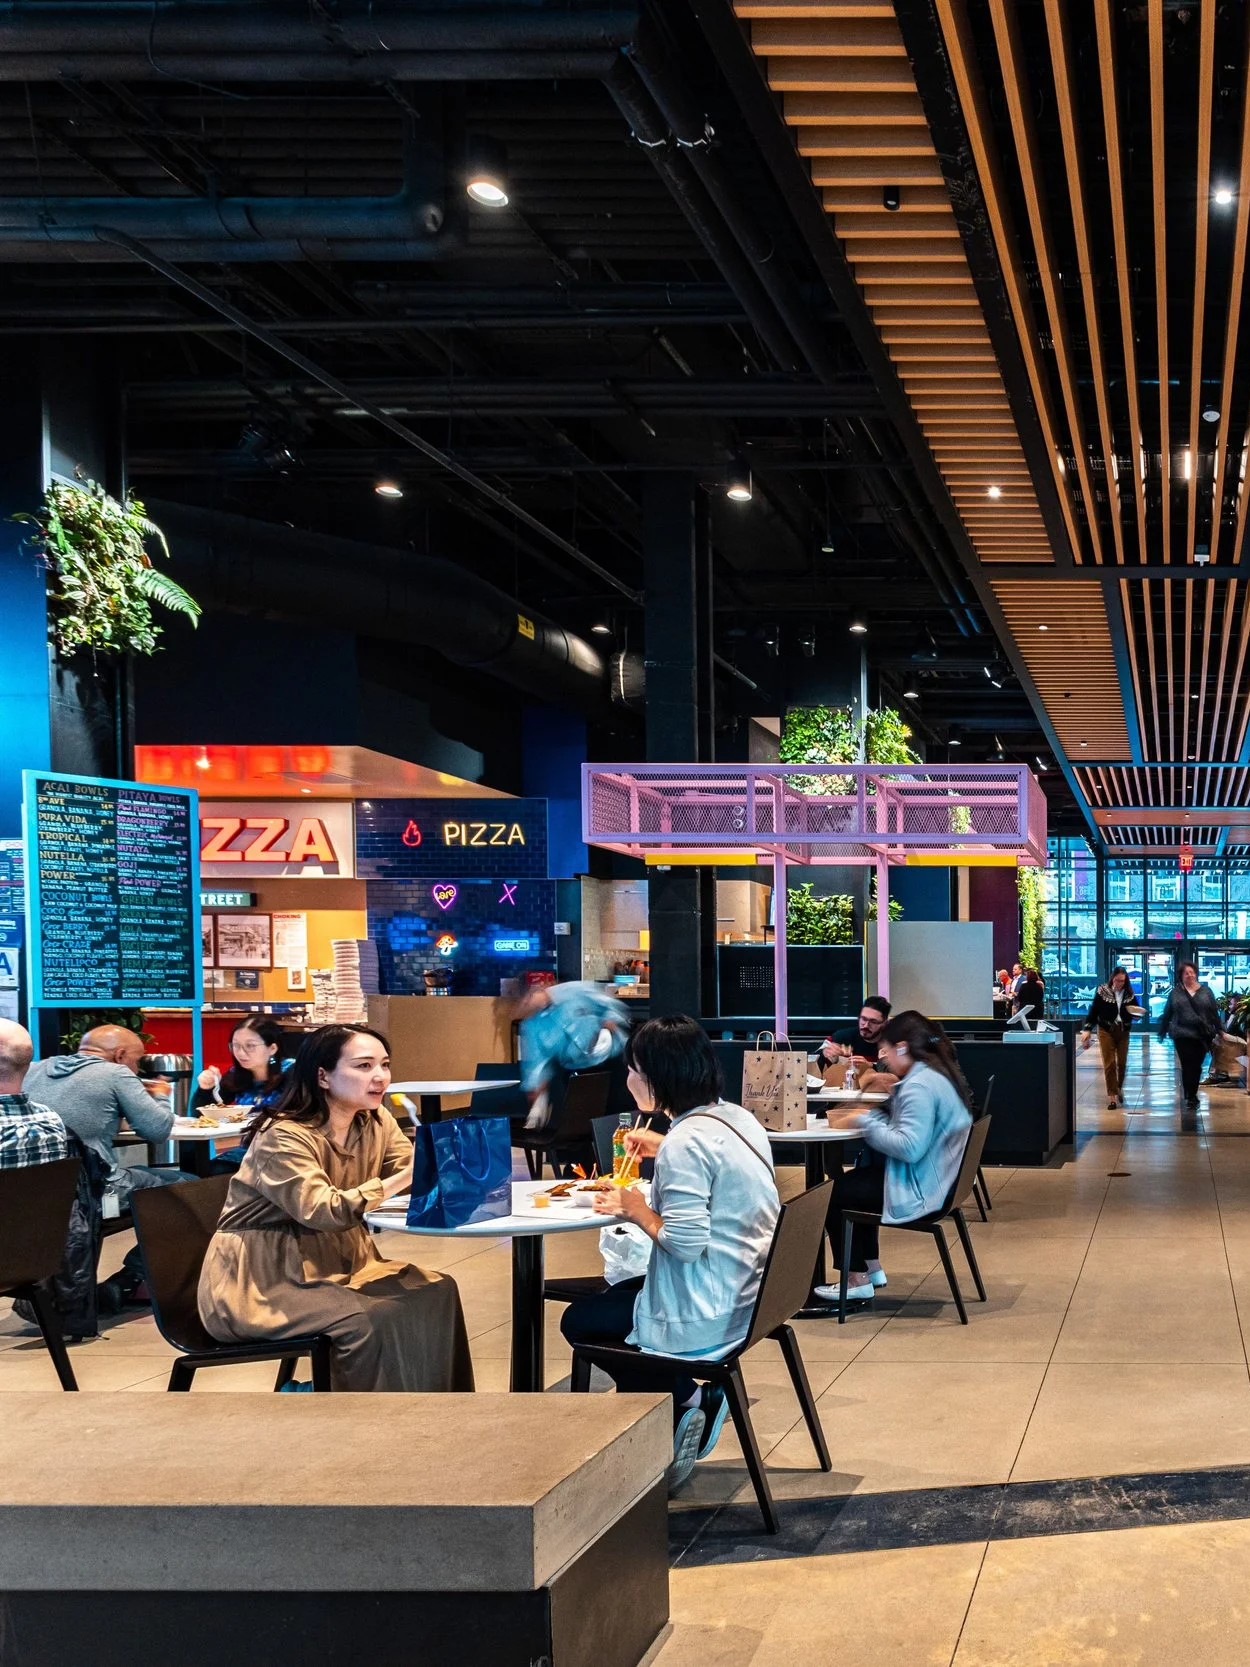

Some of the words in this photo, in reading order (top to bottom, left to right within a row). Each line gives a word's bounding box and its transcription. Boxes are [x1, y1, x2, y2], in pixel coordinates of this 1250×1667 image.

[43, 781, 70, 793] ACAI
[75, 785, 109, 797] BOWLS
[118, 790, 156, 802] PITAYA
[39, 812, 63, 821] PURA
[116, 816, 169, 827] DRAGONBERRY
[39, 831, 88, 842] TROPICAL
[444, 822, 526, 847] PIZZA
[40, 851, 85, 861] NUTELLA
[1180, 857, 1192, 867] EXIT
[41, 870, 76, 880] POWER
[41, 891, 88, 902] COCONUT
[121, 895, 154, 905] GREEN
[157, 897, 183, 906] BOWLS
[199, 894, 243, 905] TREET
[746, 1083, 765, 1099] Thank
